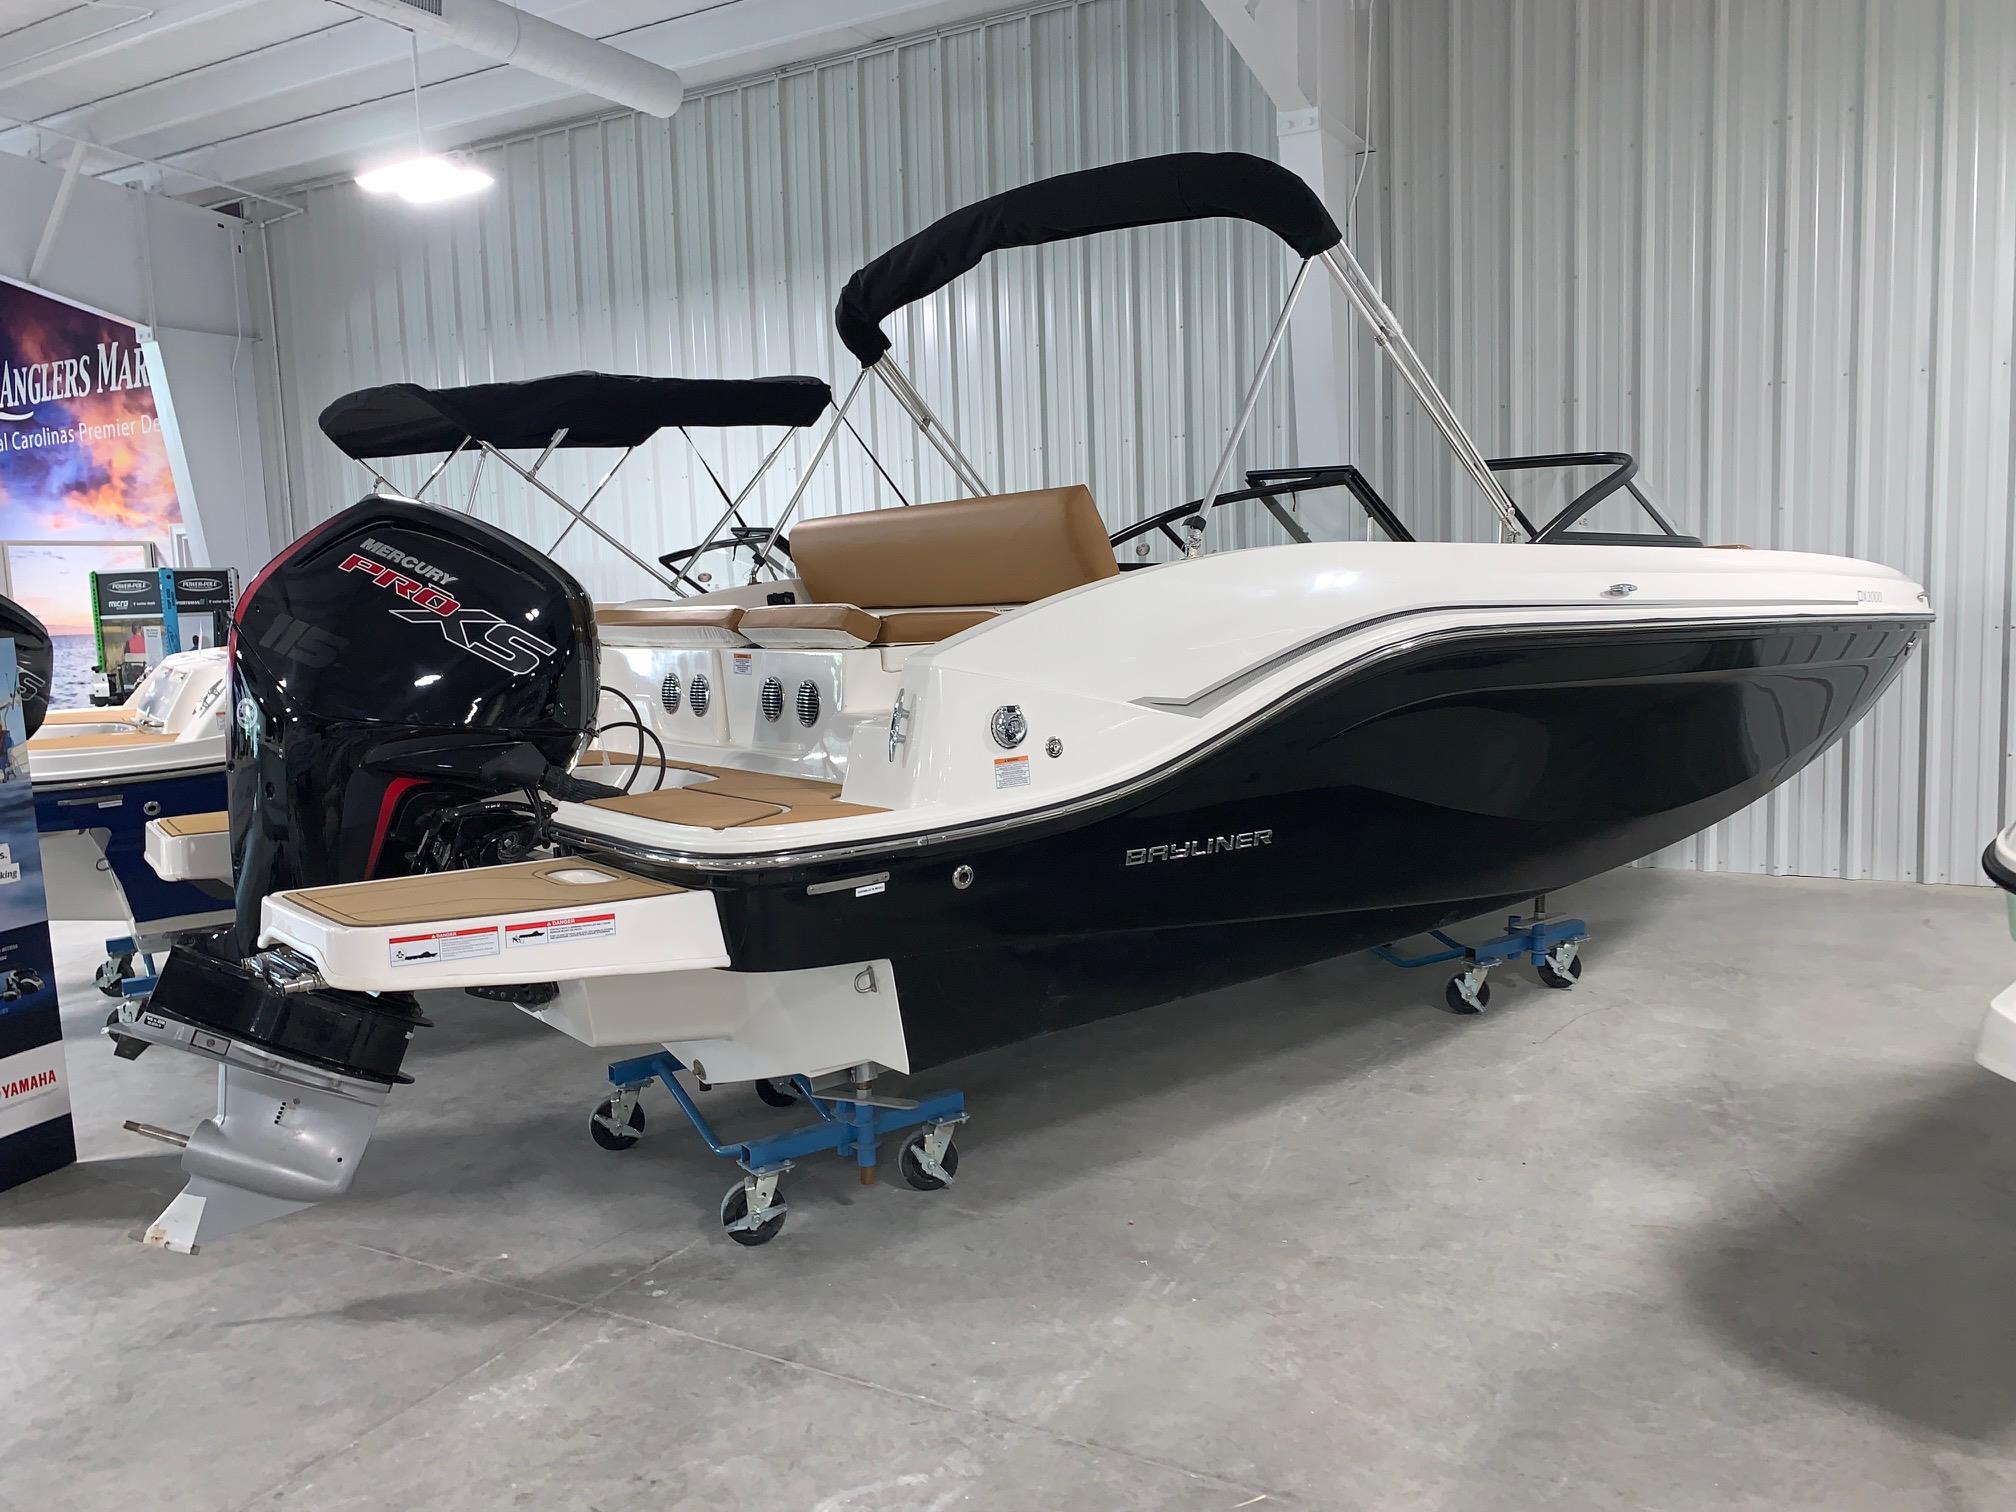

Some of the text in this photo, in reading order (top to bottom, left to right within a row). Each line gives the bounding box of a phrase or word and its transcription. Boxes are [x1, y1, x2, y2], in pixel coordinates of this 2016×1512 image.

[0, 355, 91, 408] ANGLERS
[11, 427, 75, 449] Carolinas
[78, 418, 136, 441] Premier
[360, 537, 459, 584] MERCURY
[338, 553, 557, 675] PRO XS
[259, 613, 349, 668] 115
[1125, 829, 1273, 866] BAYLINER
[551, 918, 576, 926] DANGER
[2, 1069, 57, 1099] YAMAHA
